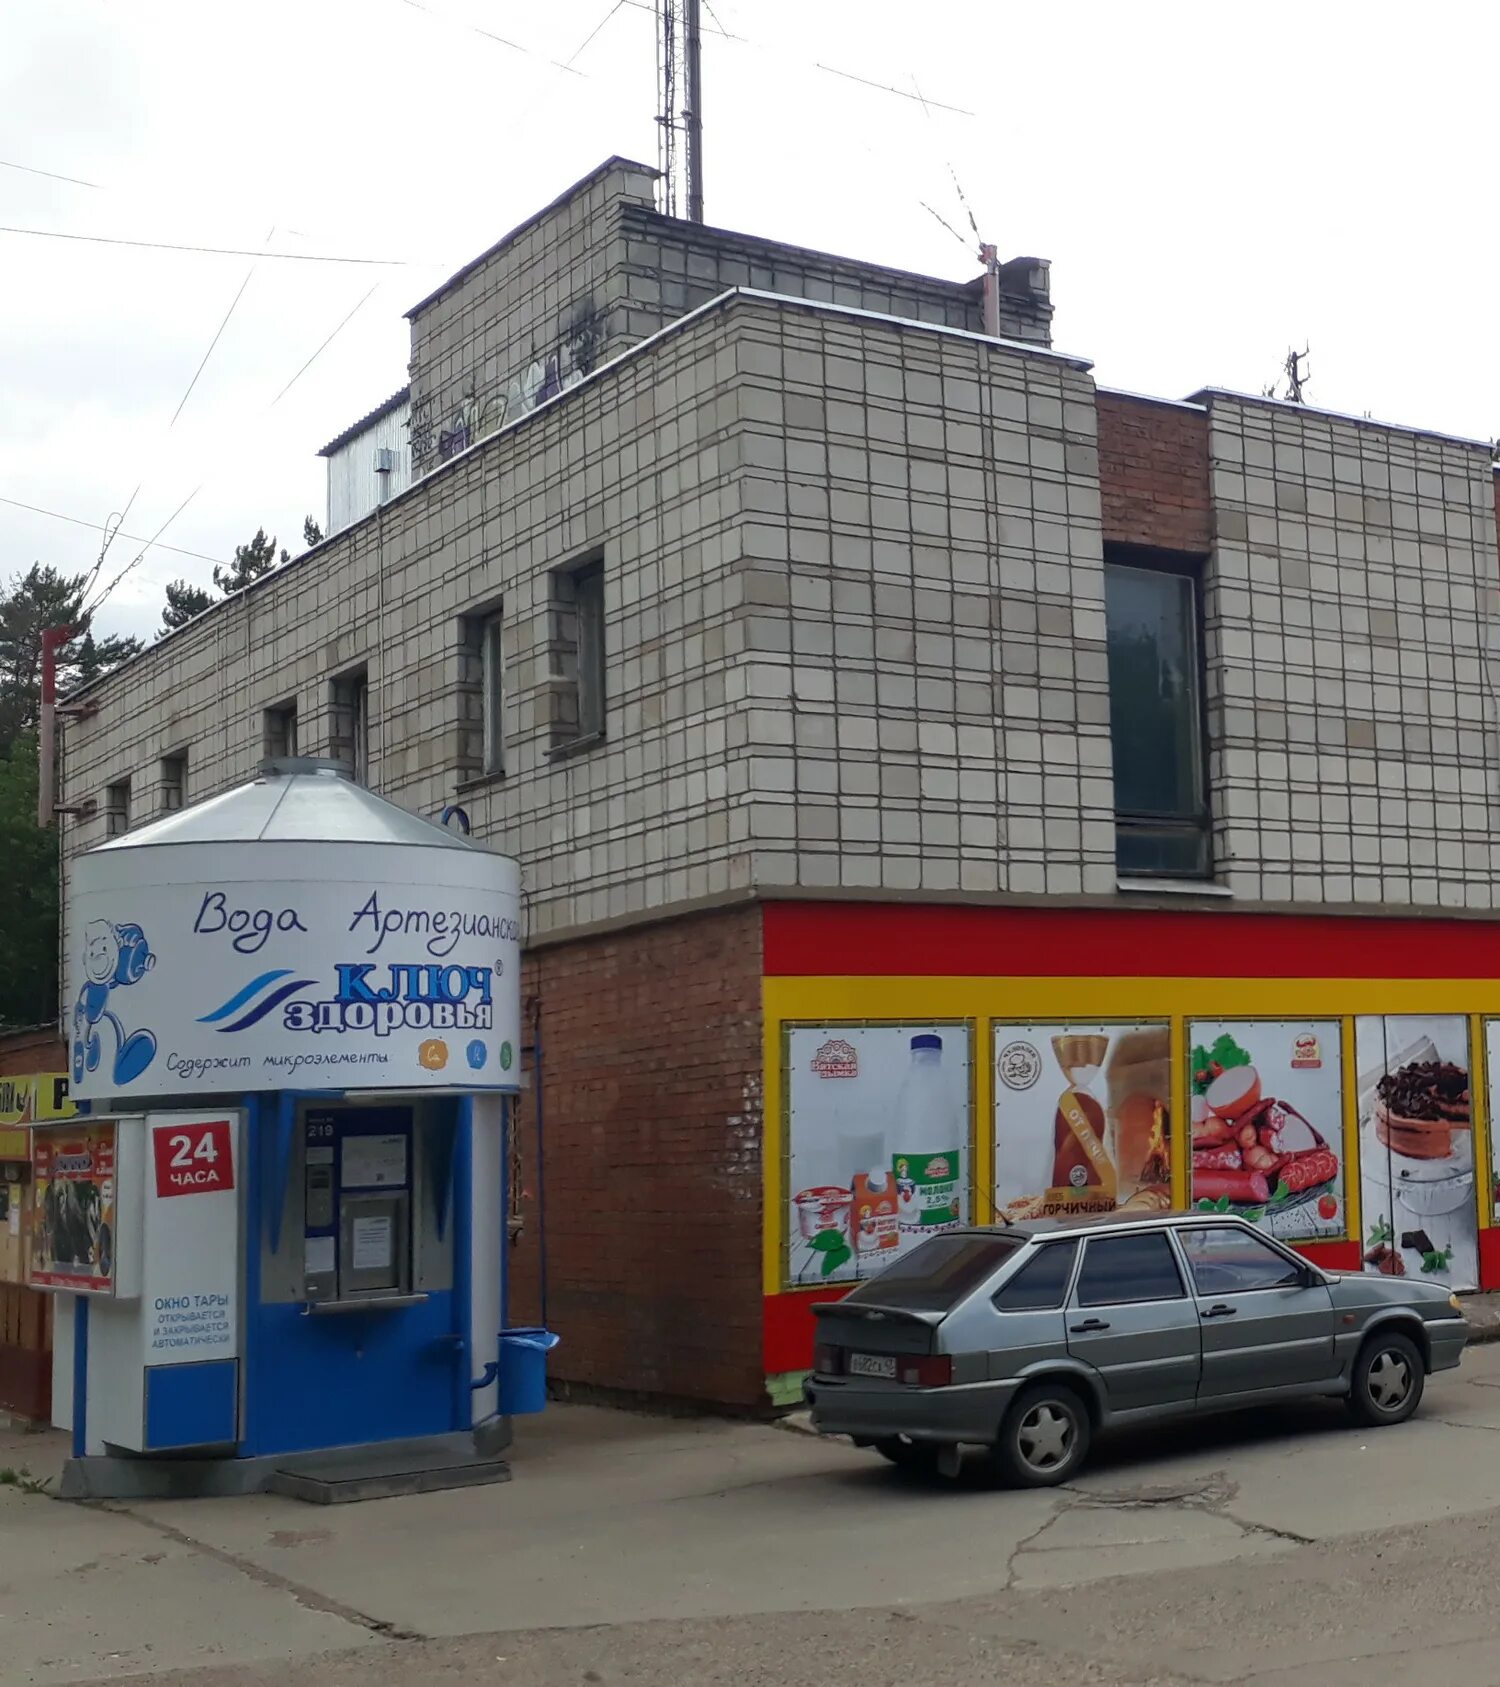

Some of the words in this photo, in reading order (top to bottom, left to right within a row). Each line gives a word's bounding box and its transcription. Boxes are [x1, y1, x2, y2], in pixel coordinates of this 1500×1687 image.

[193, 891, 307, 953] Вода
[166, 1052, 251, 1078] Содержит
[262, 1053, 389, 1075] микроэлементы
[168, 1132, 219, 1168] 24
[170, 1169, 220, 1186] ЧАСА
[1043, 1198, 1117, 1216] ГОРЧИЧНЫЙ
[154, 1296, 190, 1311] ОКНО
[194, 1294, 230, 1308] ТАРЫ
[157, 1310, 227, 1324] ОТКРЫВАЕТСЯ
[162, 1322, 230, 1336] ЗАКРЫВАЕТСЯ
[151, 1334, 231, 1349] АВТОМАТИЧЕСКИ
